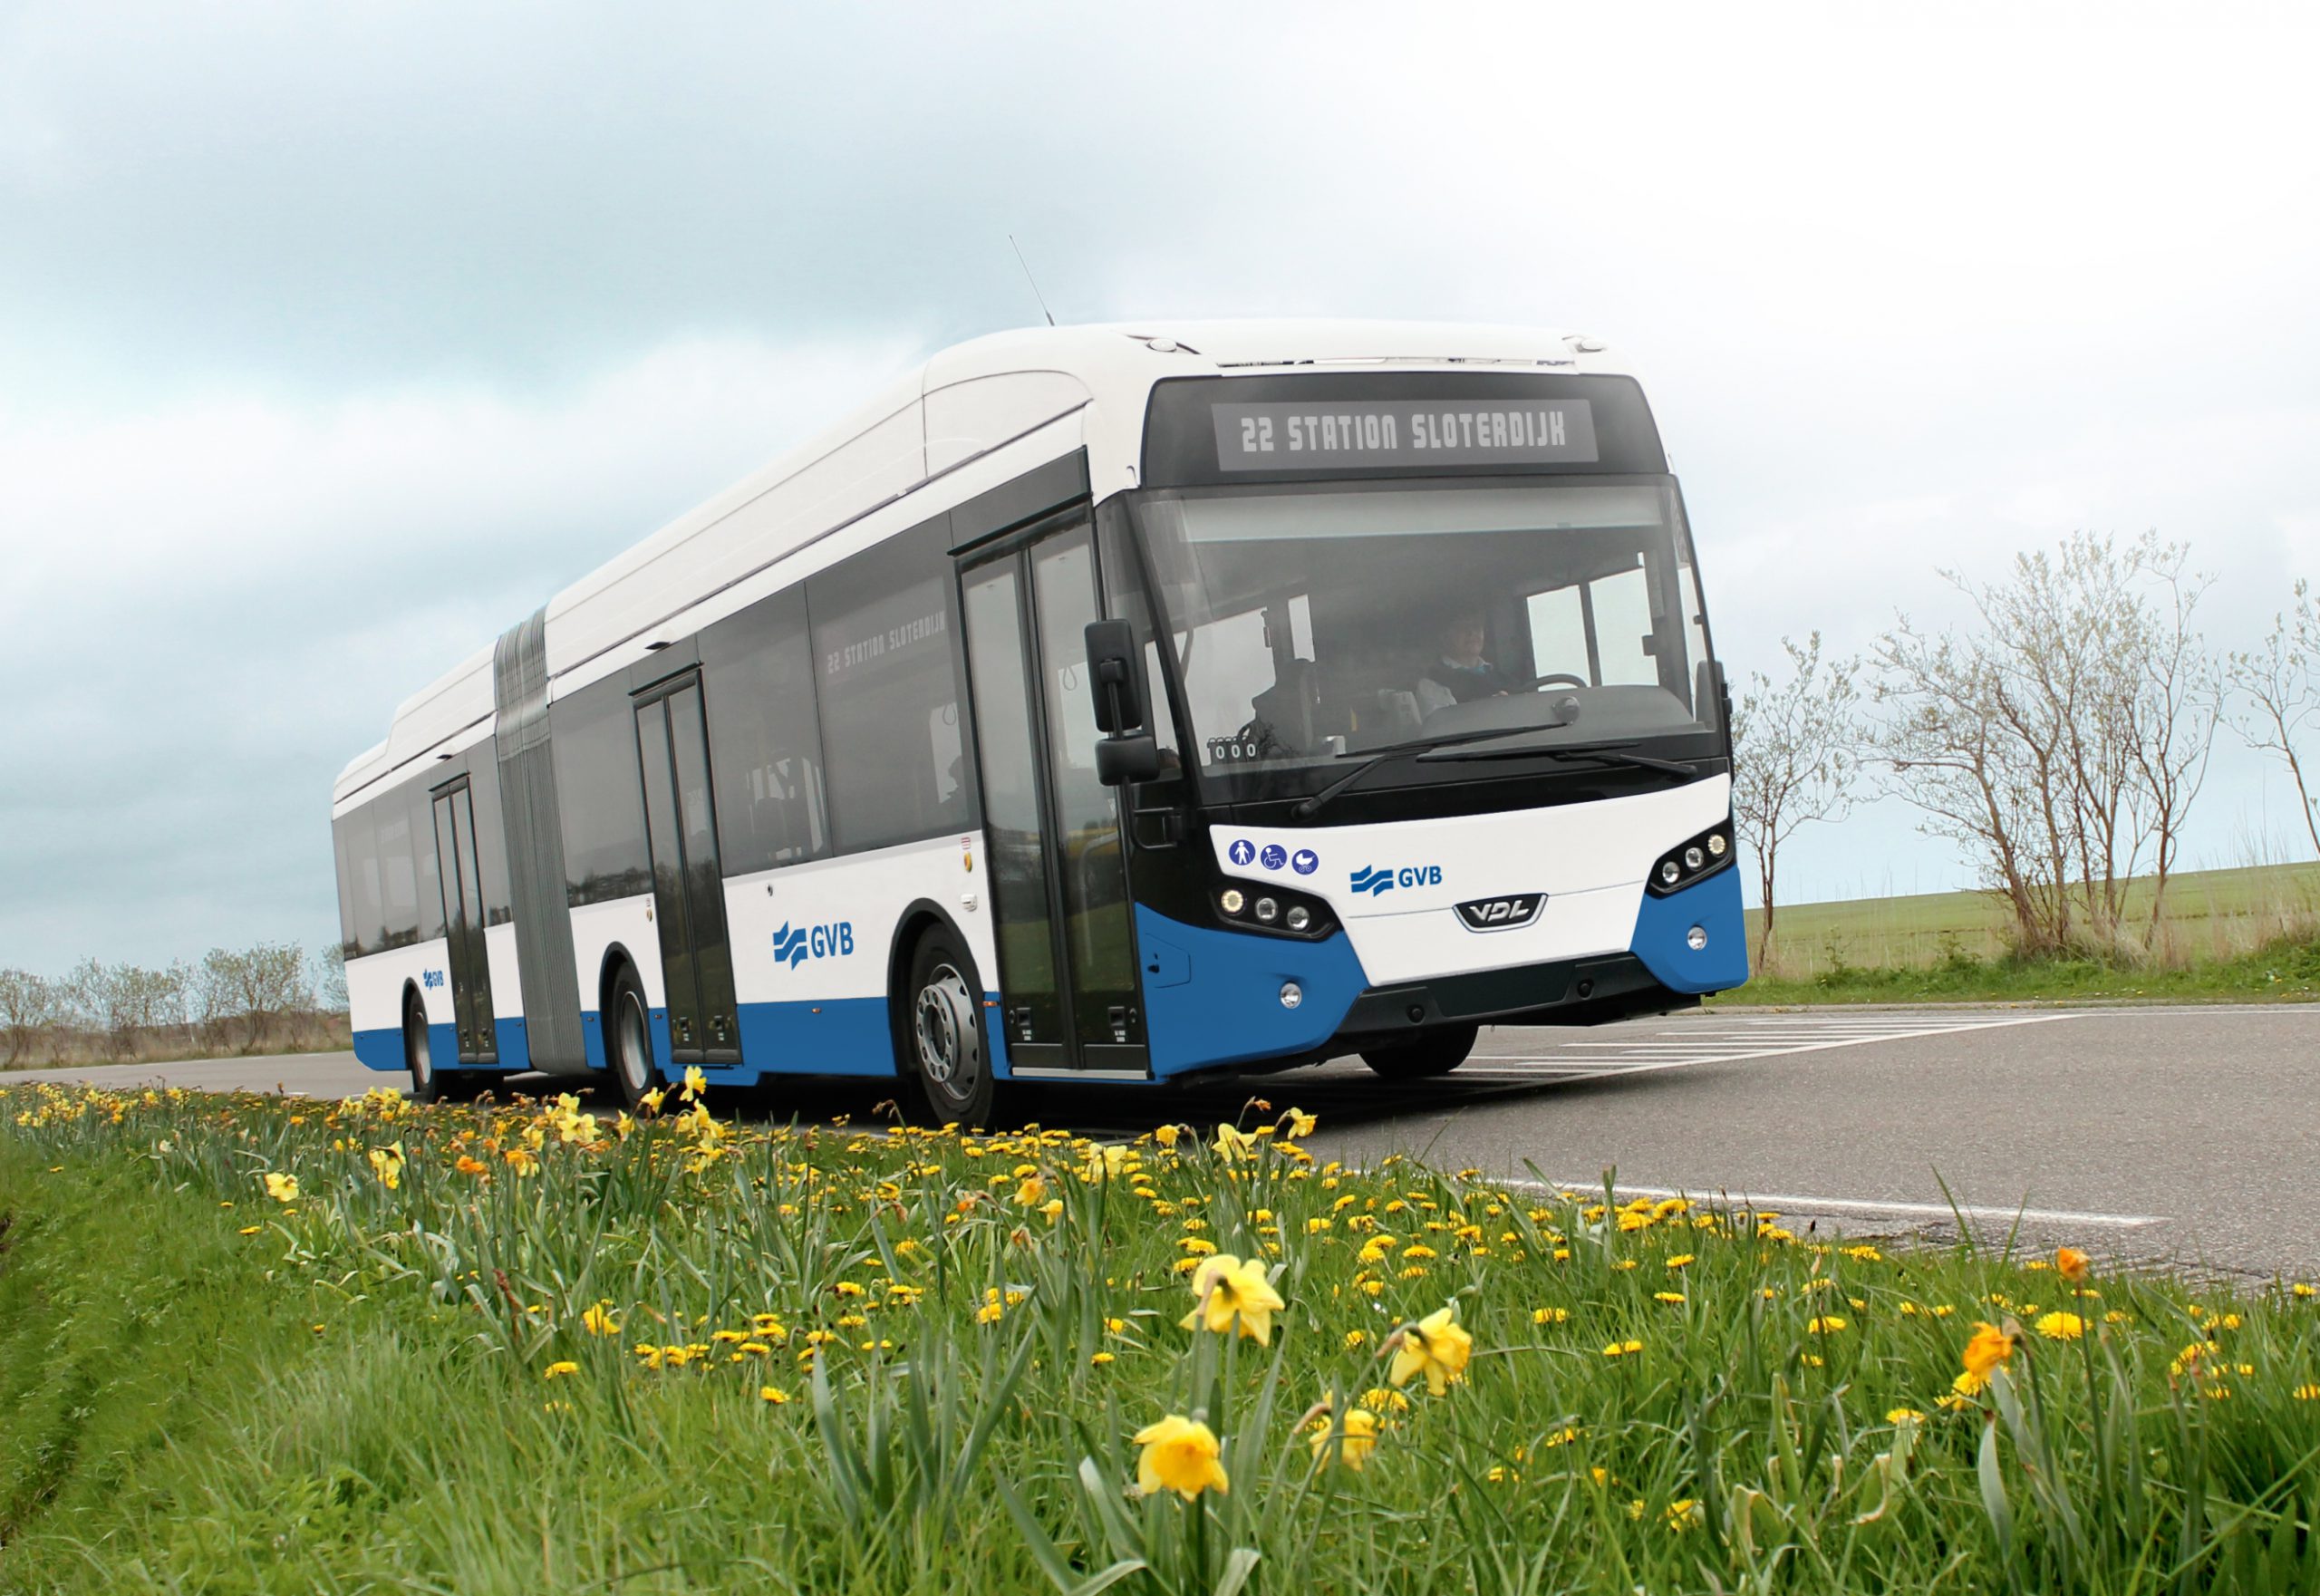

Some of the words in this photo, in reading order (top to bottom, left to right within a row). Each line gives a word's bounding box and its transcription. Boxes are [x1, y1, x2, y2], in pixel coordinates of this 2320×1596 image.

[1241, 417, 1274, 452] 22
[1287, 414, 1397, 450] STATION
[1411, 411, 1566, 449] SLOTERDIJK
[827, 651, 840, 674] 22
[844, 634, 884, 667] STATION
[1398, 866, 1443, 888] GVB
[1469, 900, 1530, 922] VDL
[810, 921, 854, 958] GVB
